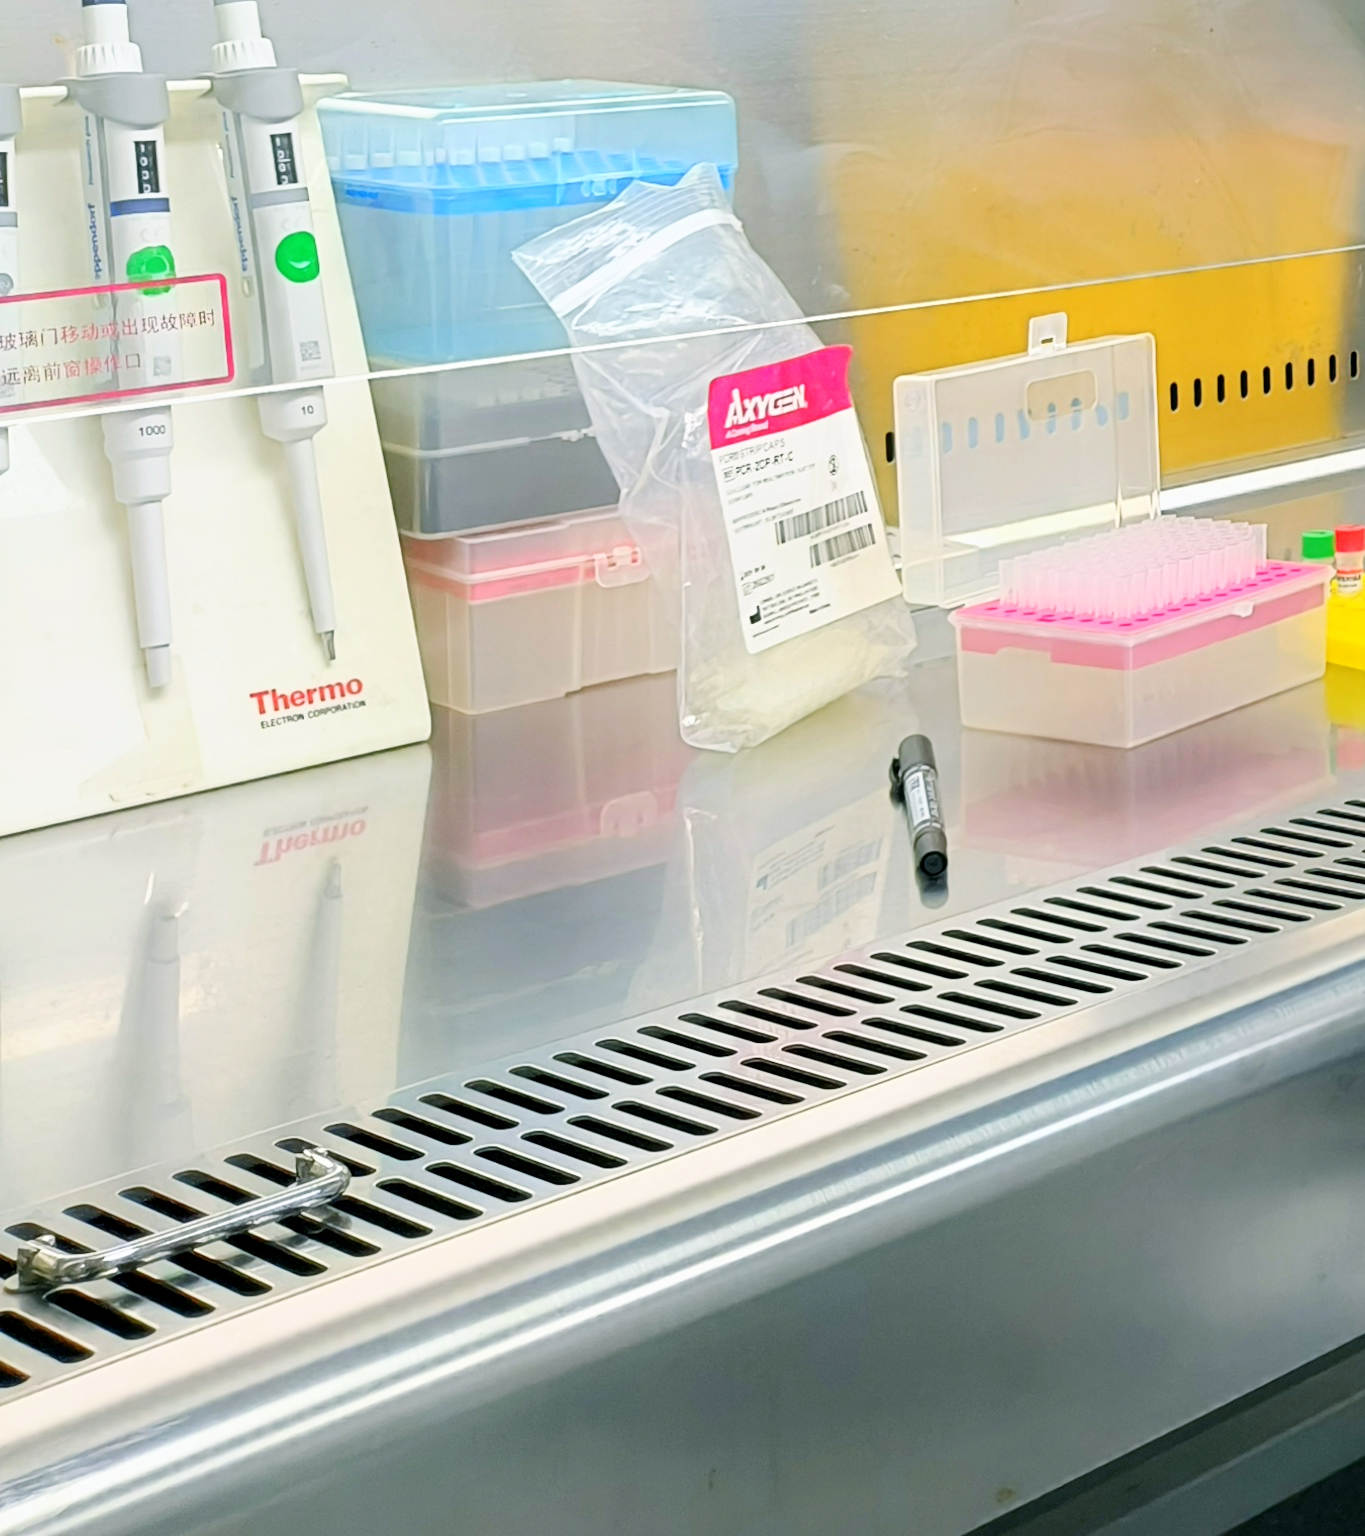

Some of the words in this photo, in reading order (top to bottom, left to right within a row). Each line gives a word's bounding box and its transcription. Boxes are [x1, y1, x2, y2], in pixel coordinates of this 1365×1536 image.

[1, 353, 142, 386] 远离前窗操作口
[301, 405, 315, 416] 10
[138, 424, 167, 437] 1000
[250, 678, 364, 715] Thermo
[260, 713, 305, 729] ELECTRON
[307, 700, 367, 719] CORPORATION
